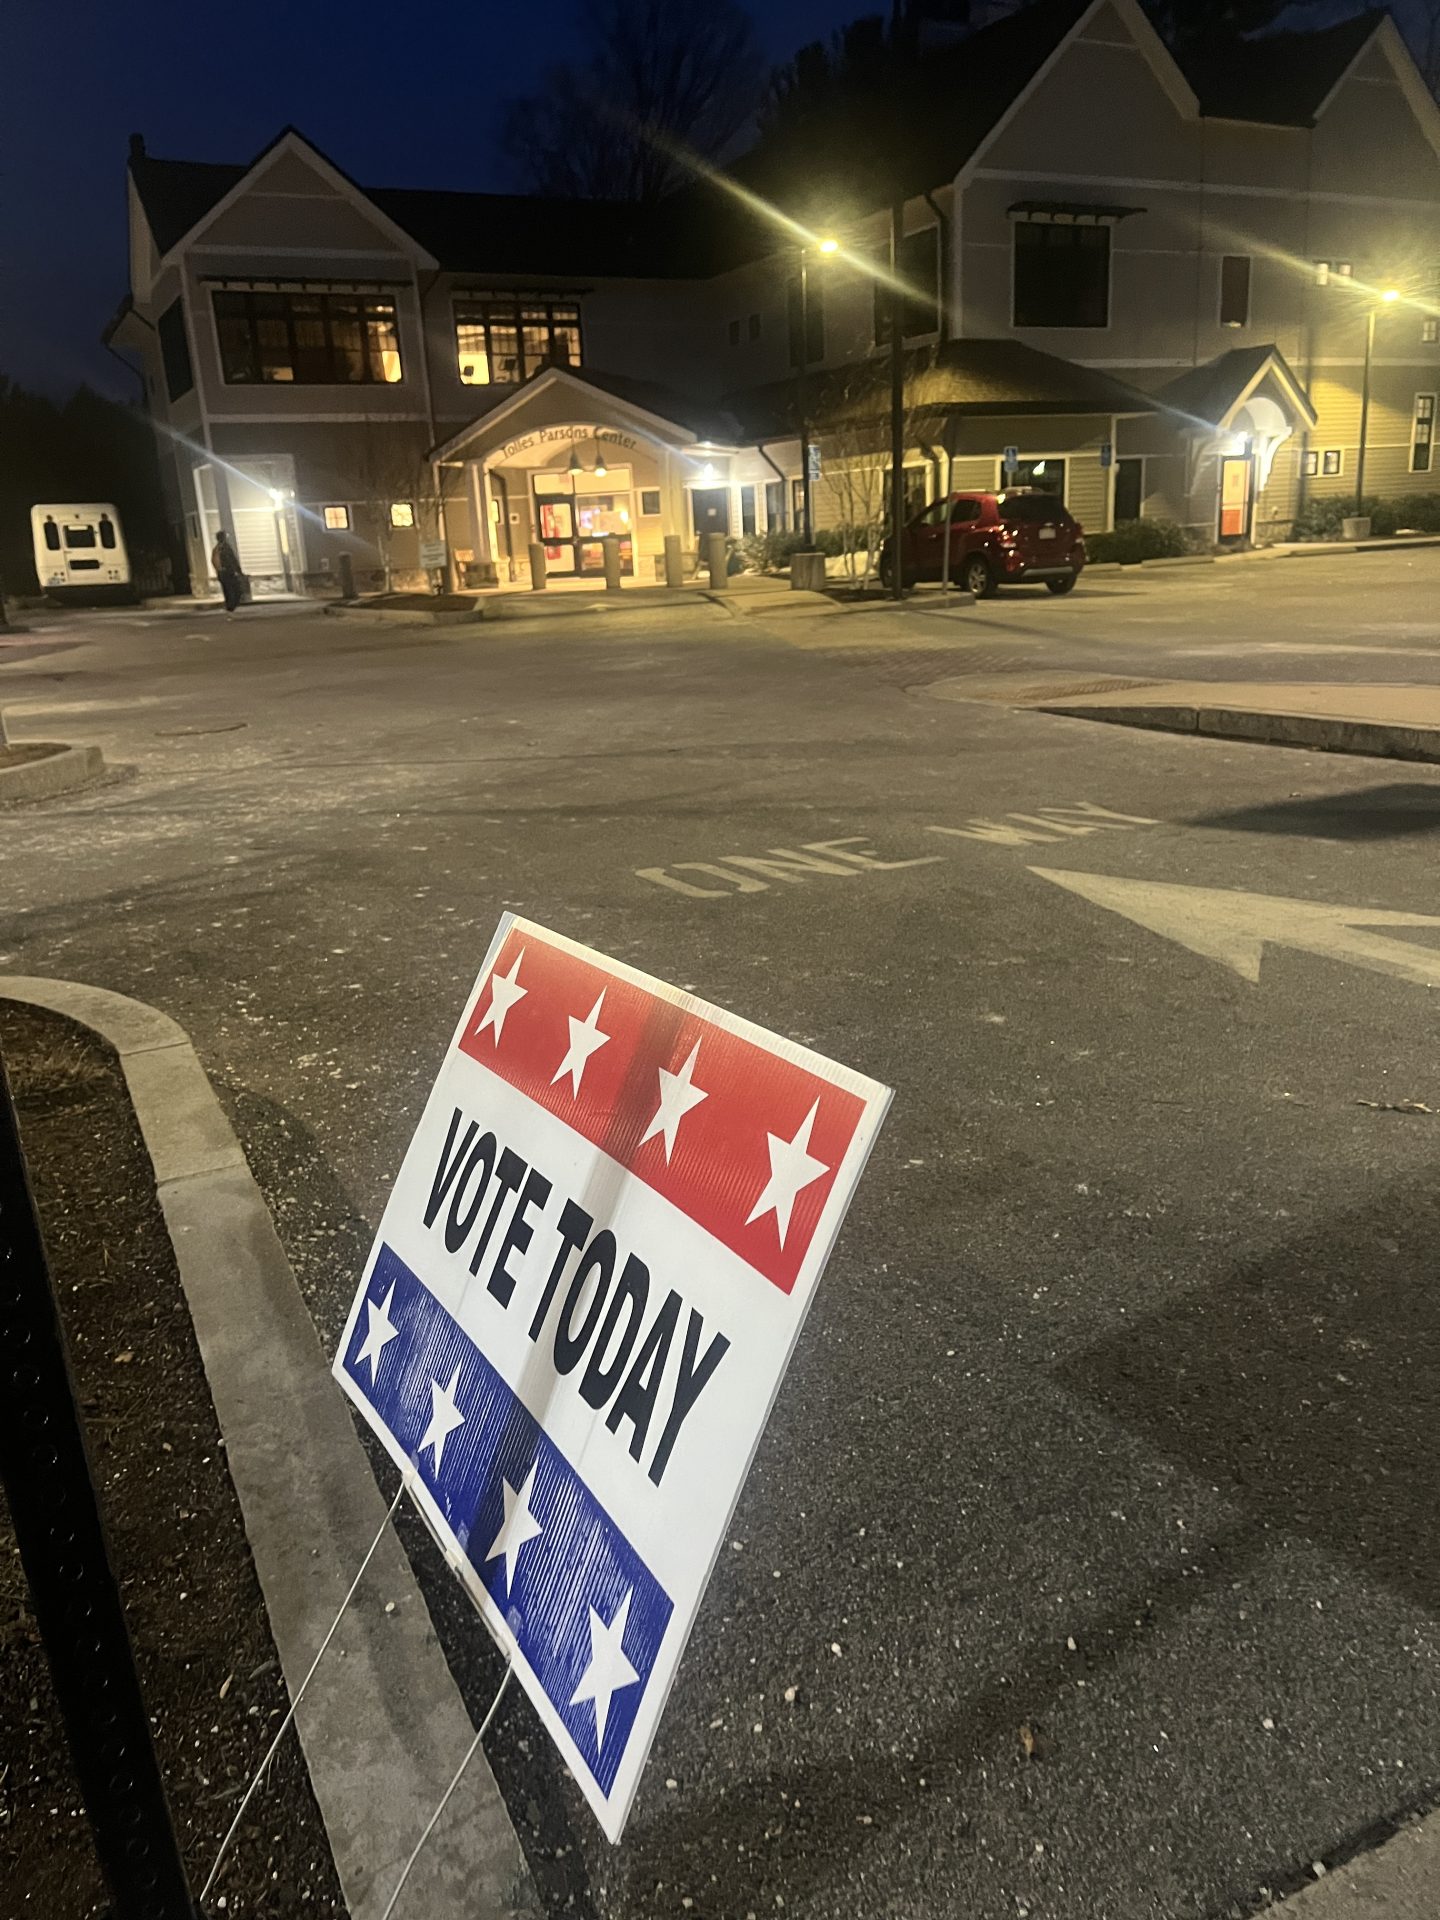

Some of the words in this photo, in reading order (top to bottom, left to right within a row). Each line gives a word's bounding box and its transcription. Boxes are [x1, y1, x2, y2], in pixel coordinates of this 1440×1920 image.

[502, 436, 535, 458] Tolles
[539, 426, 588, 443] Parsons
[593, 426, 637, 449] Center
[634, 837, 947, 898] ONE
[924, 801, 1163, 846] WAY
[423, 1107, 553, 1310] VOTE
[528, 1197, 731, 1488] TODAY
